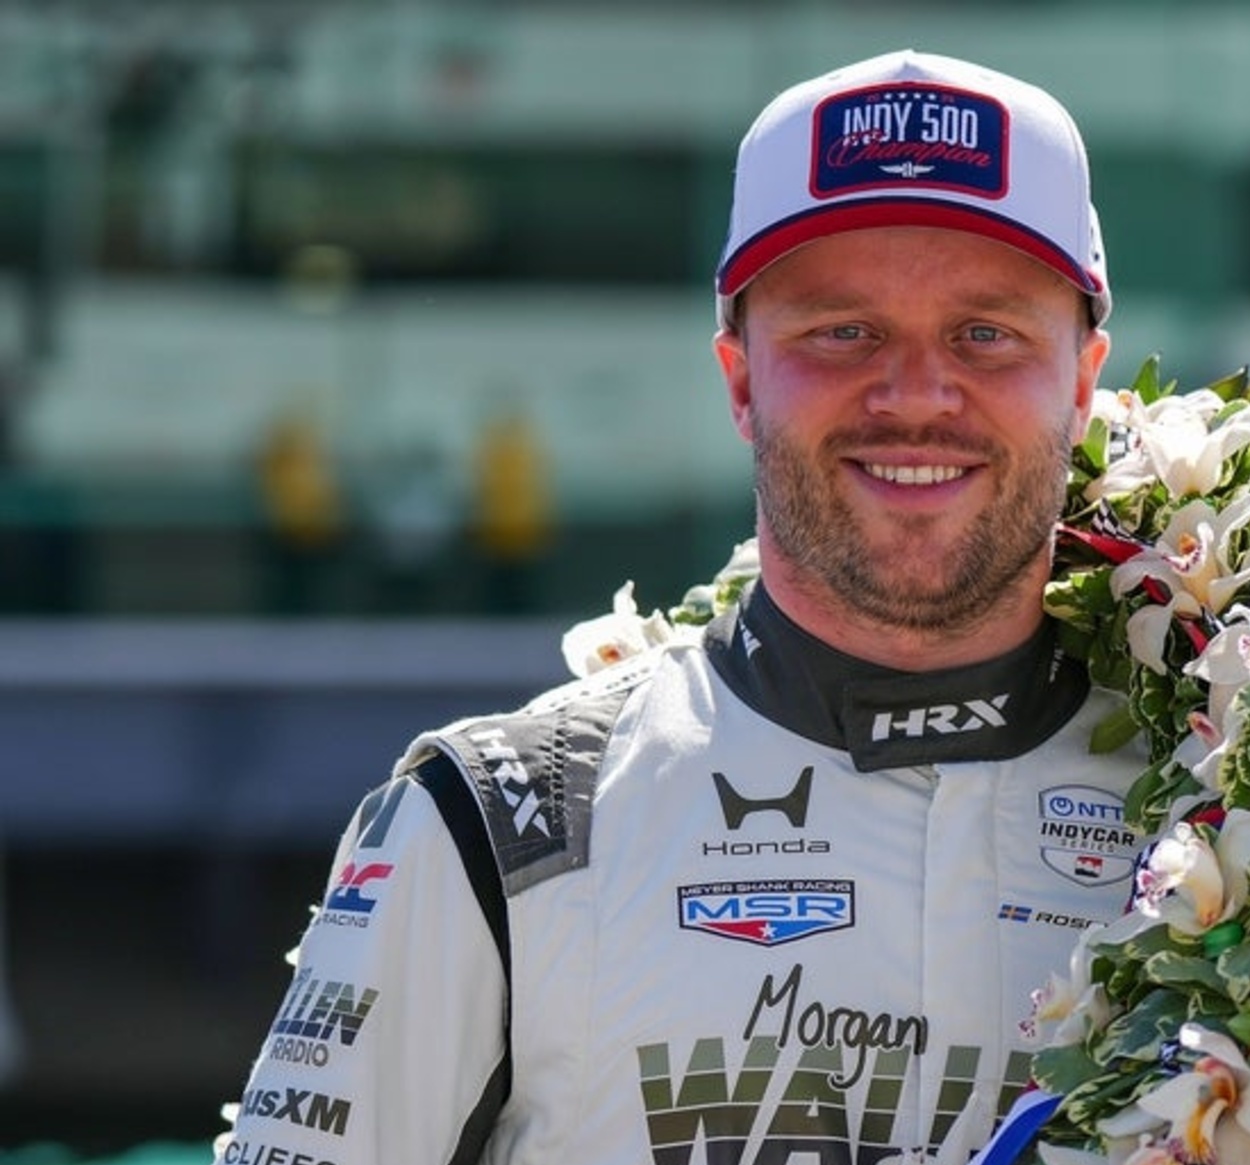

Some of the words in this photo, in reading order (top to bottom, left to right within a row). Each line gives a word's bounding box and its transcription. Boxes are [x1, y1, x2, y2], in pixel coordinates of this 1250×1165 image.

[843, 101, 912, 146] INDY
[921, 103, 978, 149] 500
[827, 128, 992, 168] Champion
[872, 694, 1010, 742] HRX
[1079, 802, 1123, 821] NTT
[703, 837, 831, 855] Honda
[1041, 822, 1136, 846] INDYCAR
[1061, 839, 1116, 853] SERIES
[681, 883, 733, 897] MEYER
[736, 881, 788, 893] SHANK
[792, 880, 851, 893] RACING
[687, 895, 846, 921] MSR
[273, 978, 380, 1047] LLEN
[743, 963, 929, 1089] Morgan
[270, 1036, 330, 1068] RADIO
